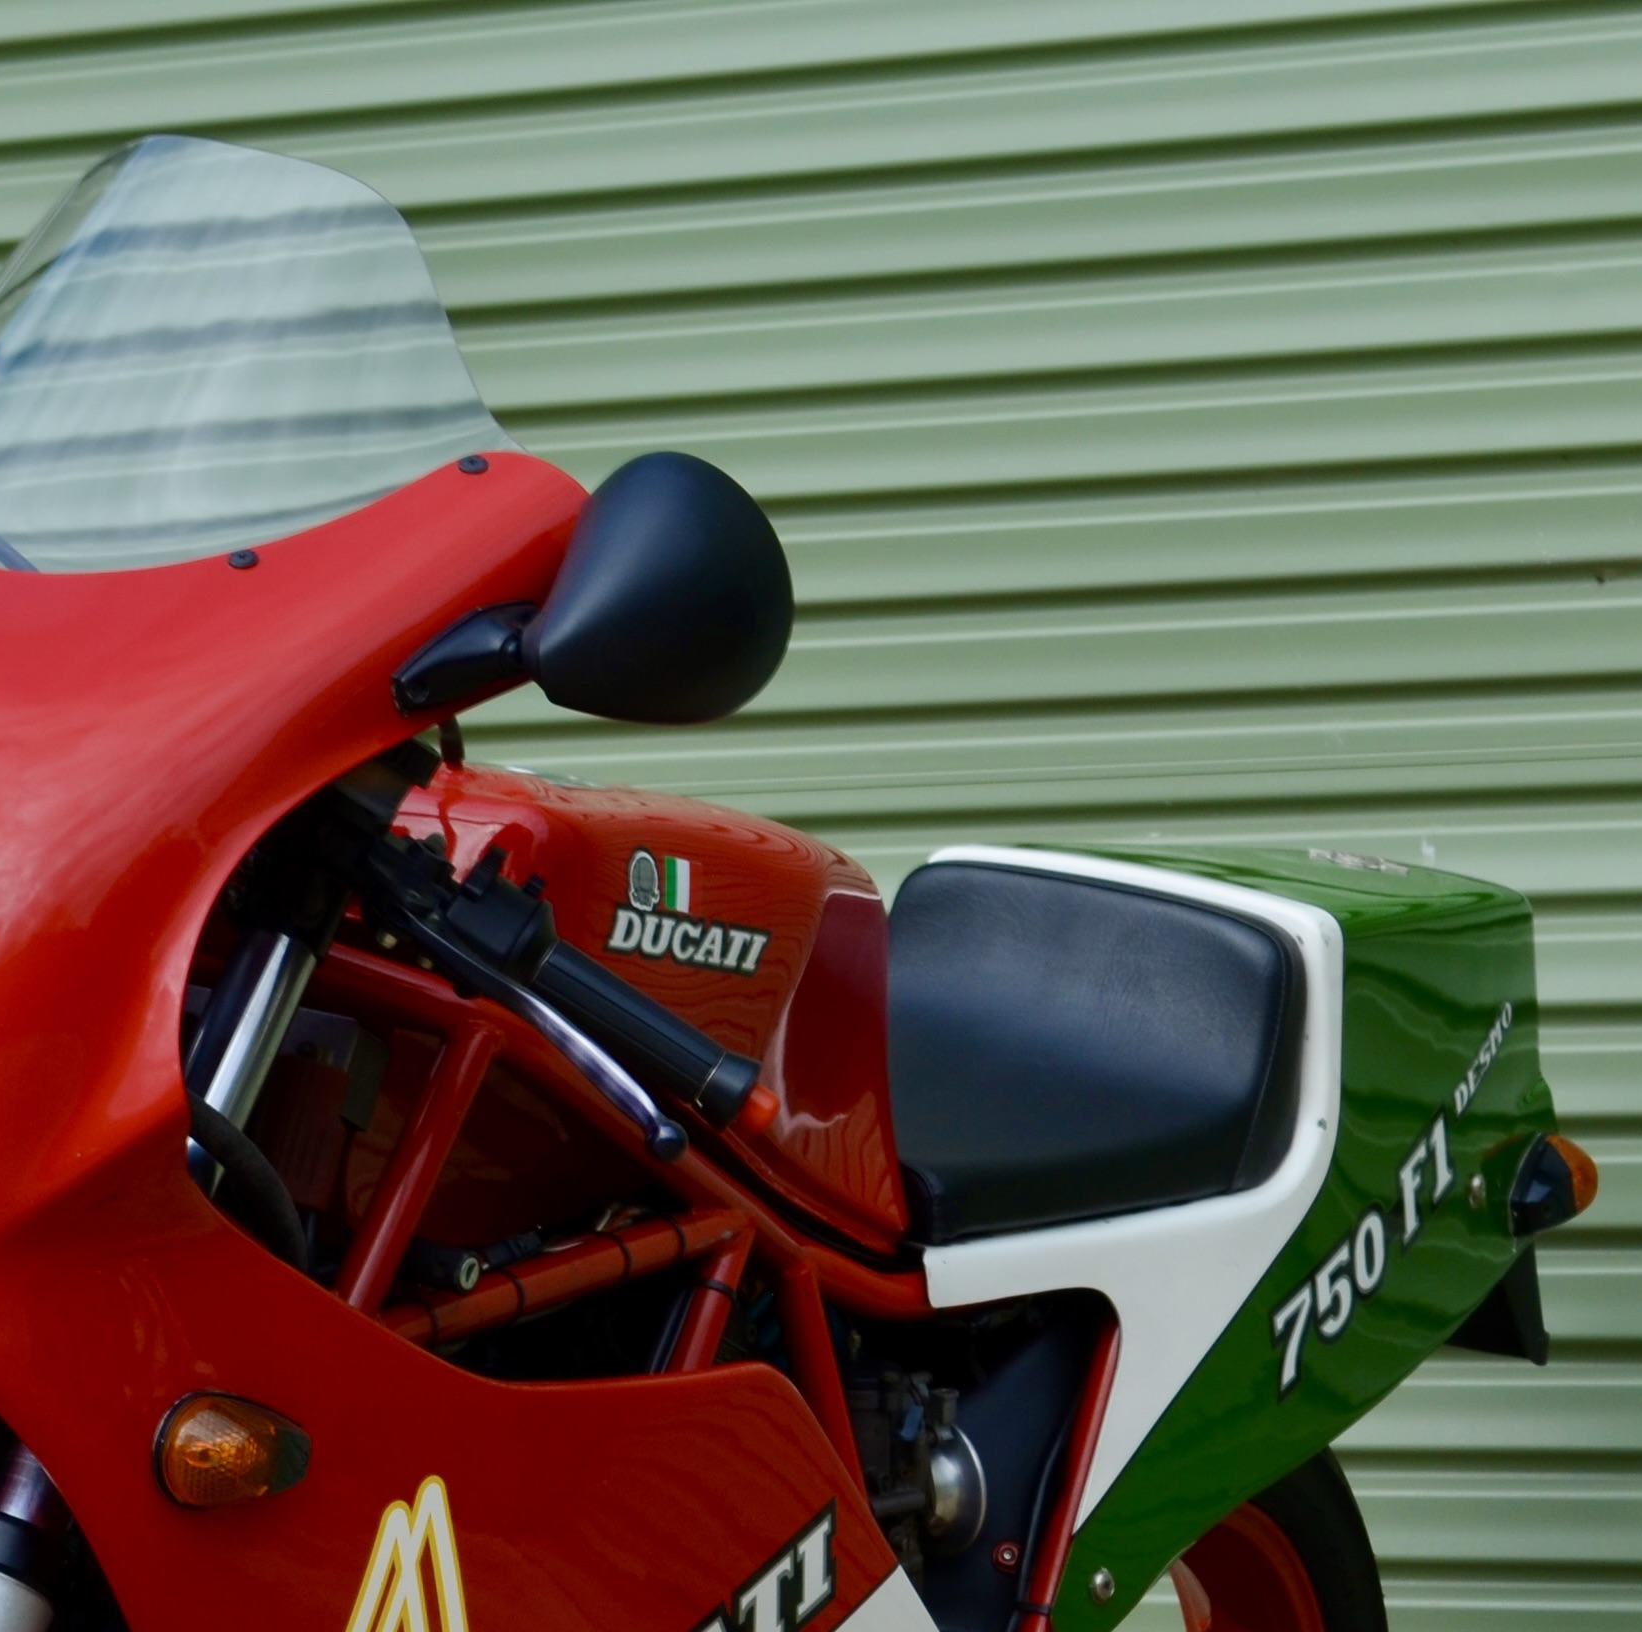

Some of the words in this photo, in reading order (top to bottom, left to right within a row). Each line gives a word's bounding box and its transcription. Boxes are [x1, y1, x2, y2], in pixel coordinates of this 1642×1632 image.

[609, 909, 768, 972] DUCATI
[1273, 1210, 1385, 1393] 750
[1399, 1112, 1454, 1245] F1
[1454, 1001, 1512, 1115] DESMO
